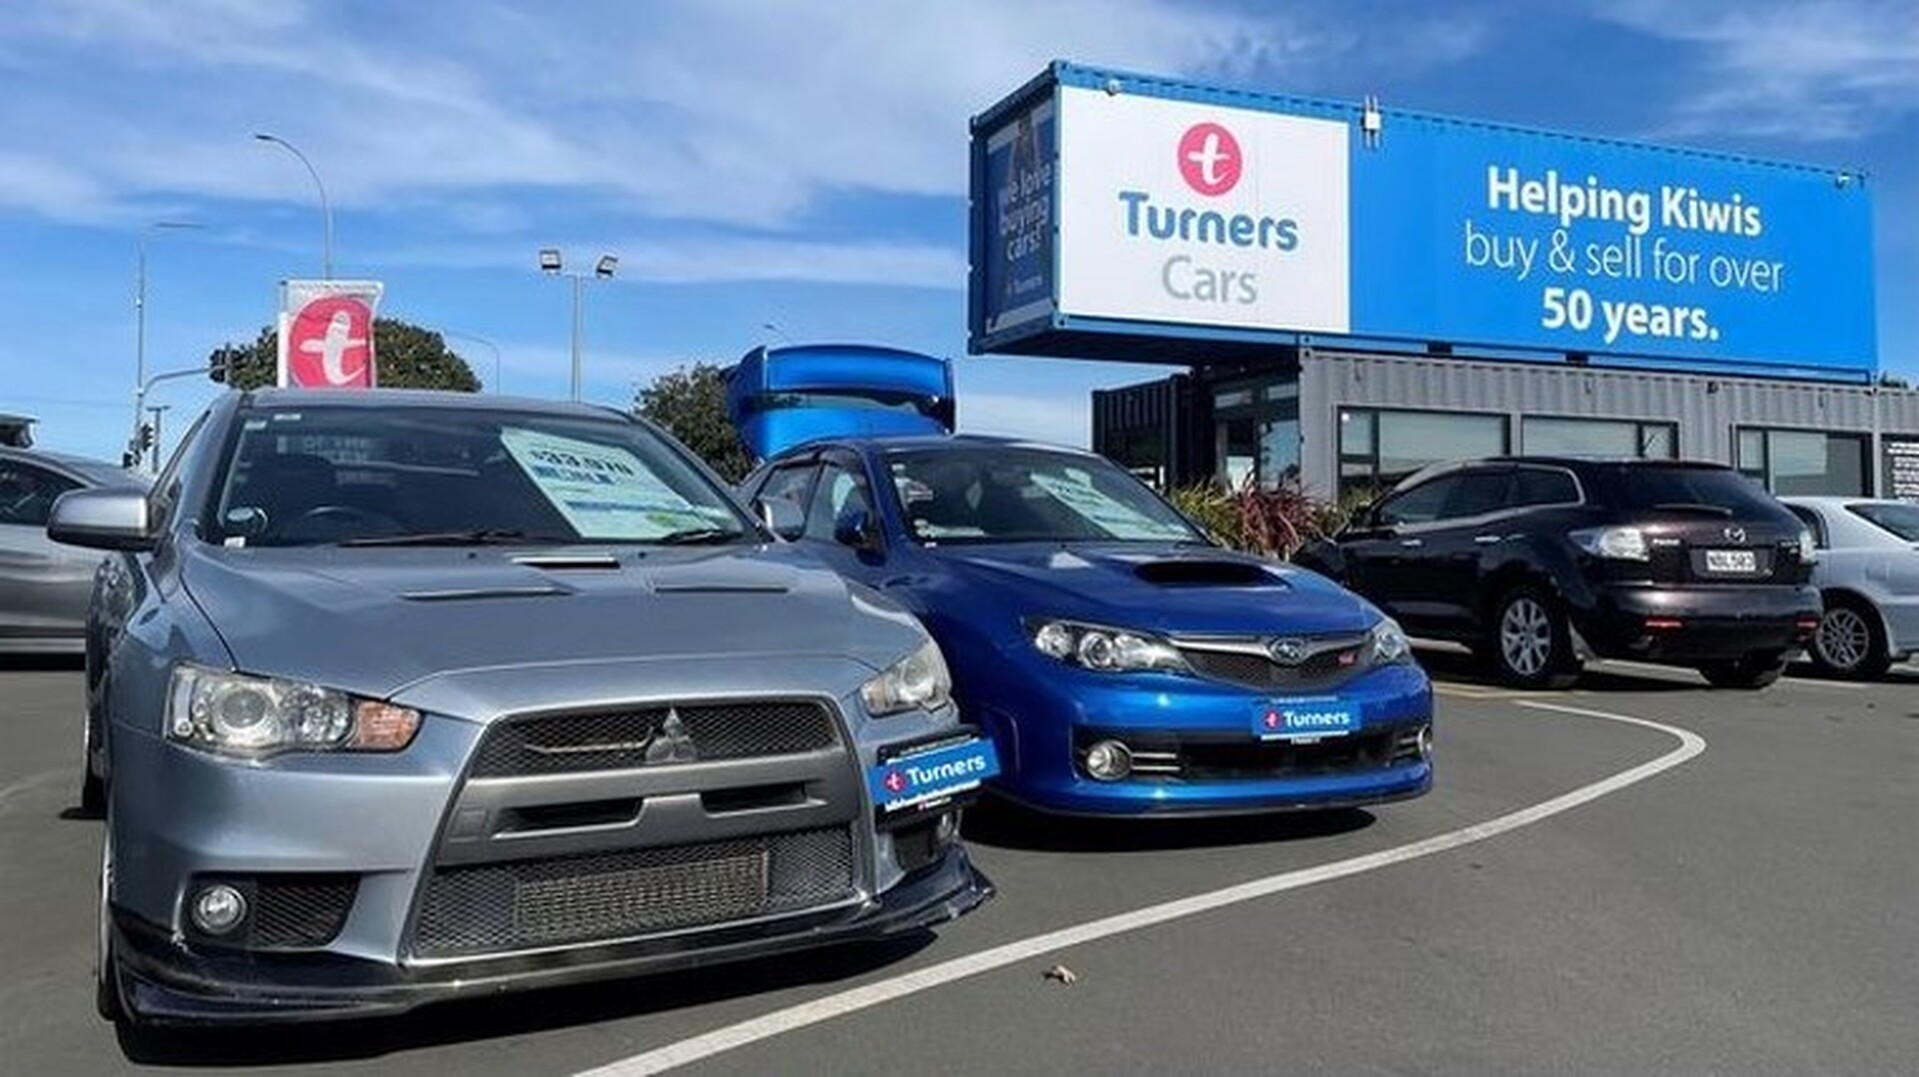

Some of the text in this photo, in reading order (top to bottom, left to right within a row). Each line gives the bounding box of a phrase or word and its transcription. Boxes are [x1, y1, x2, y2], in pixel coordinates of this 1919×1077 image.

[1118, 190, 1299, 252] Turners
[1486, 165, 1763, 237] Helping Kiwis
[1161, 254, 1258, 305] Cars
[1465, 219, 1783, 293] buy & sell for over
[1541, 285, 1720, 344] 50 years.
[1282, 710, 1350, 728] Turners
[905, 754, 986, 786] Turners
